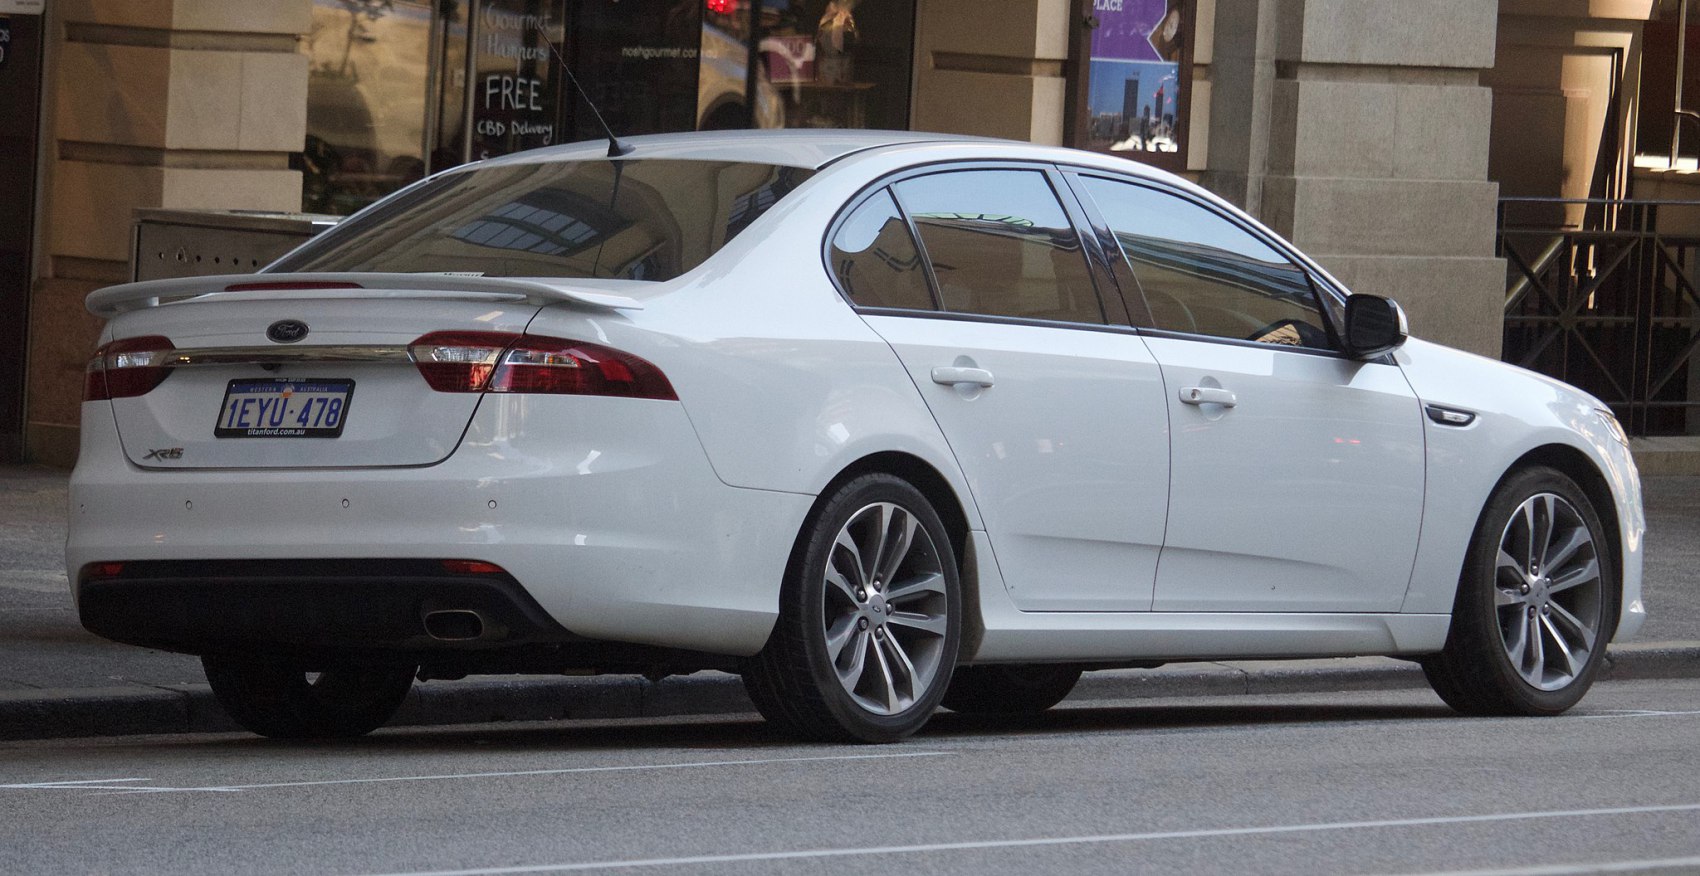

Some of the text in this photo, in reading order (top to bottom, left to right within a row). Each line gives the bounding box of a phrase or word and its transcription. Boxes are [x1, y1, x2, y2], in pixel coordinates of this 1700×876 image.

[486, 3, 552, 31] Gourmet
[486, 75, 542, 111] FREE
[477, 120, 553, 145] CBD Delivery
[247, 428, 306, 436] titanford.com.au
